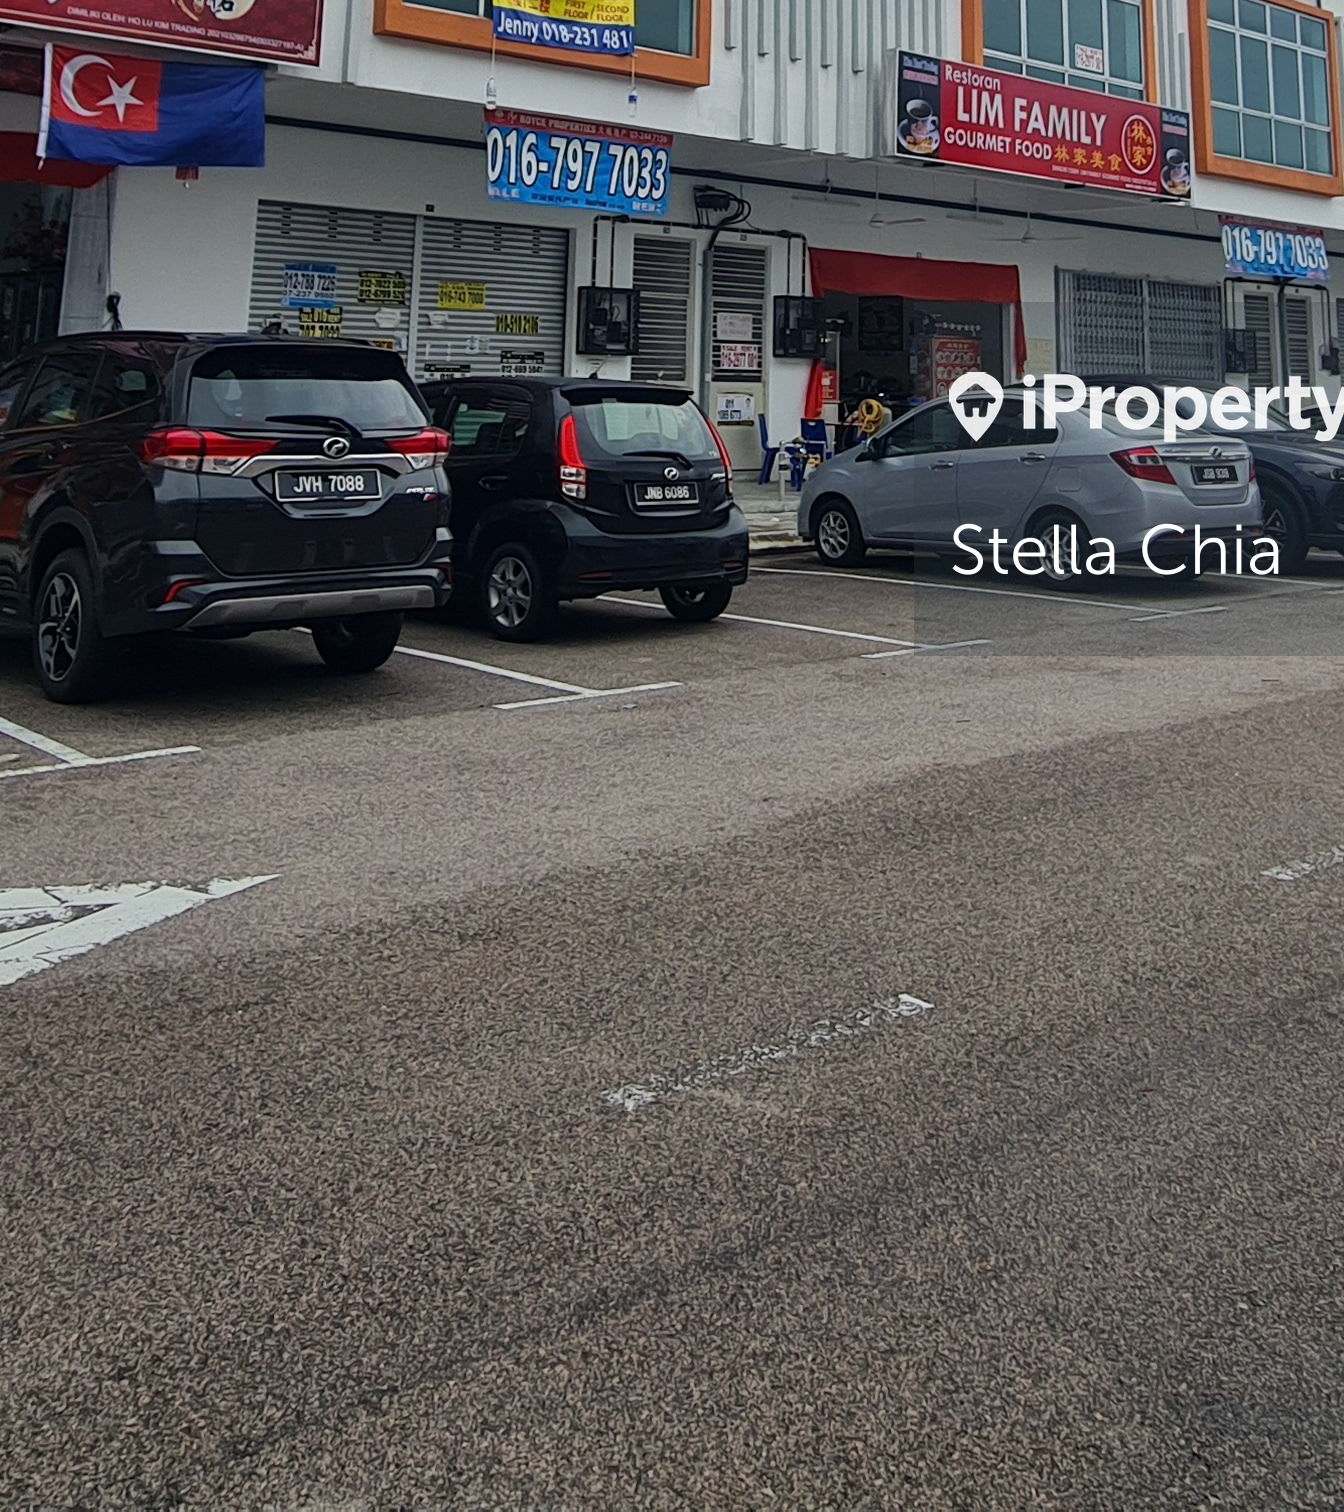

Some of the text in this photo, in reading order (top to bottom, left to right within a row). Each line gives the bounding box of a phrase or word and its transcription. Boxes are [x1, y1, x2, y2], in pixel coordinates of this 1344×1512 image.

[497, 11, 633, 48] Jenny 018-231 481
[946, 64, 1001, 91] Restoran
[957, 86, 1005, 129] LIM
[1014, 97, 1107, 146] FAMILY
[944, 126, 1052, 161] GOURMET FOOD
[1054, 144, 1123, 172] 林家美食
[487, 127, 668, 201] 016-797 7033
[1221, 225, 1329, 269] 016-797 7033
[293, 474, 365, 493] JVH 7088
[644, 485, 690, 500] JNB 6086
